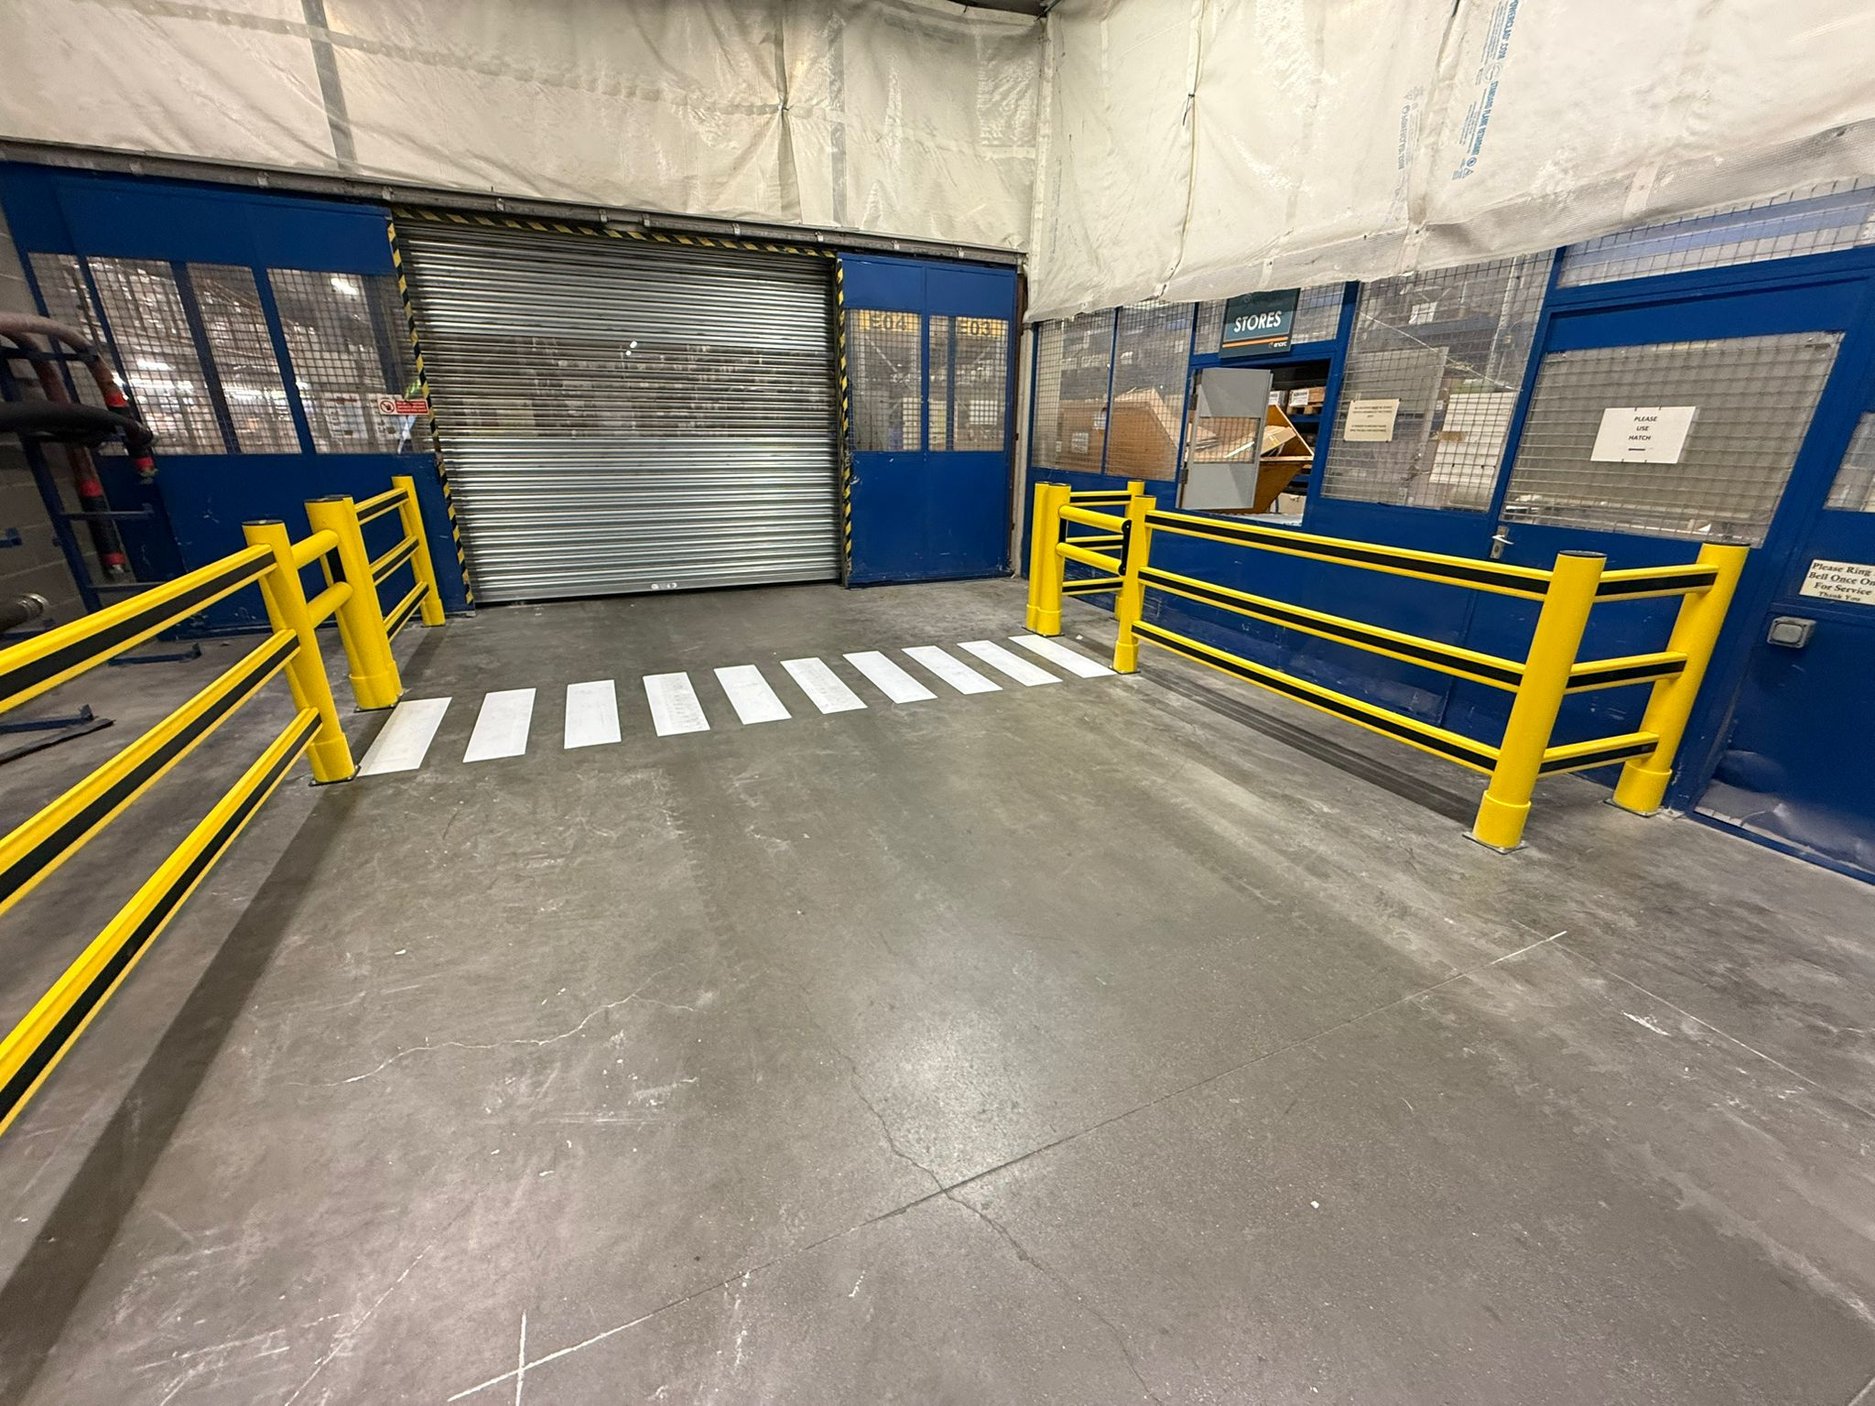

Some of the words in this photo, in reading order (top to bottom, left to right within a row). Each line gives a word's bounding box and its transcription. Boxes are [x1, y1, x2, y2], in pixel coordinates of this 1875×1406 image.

[1233, 310, 1282, 333] STORES
[1812, 562, 1844, 573] Please
[1846, 566, 1873, 577] Ring
[1809, 571, 1829, 581] Bell
[1830, 574, 1858, 585] Once
[1813, 581, 1833, 591] For
[1834, 584, 1873, 596] Service
[1818, 590, 1843, 600] Thank
[1844, 594, 1862, 602] You
